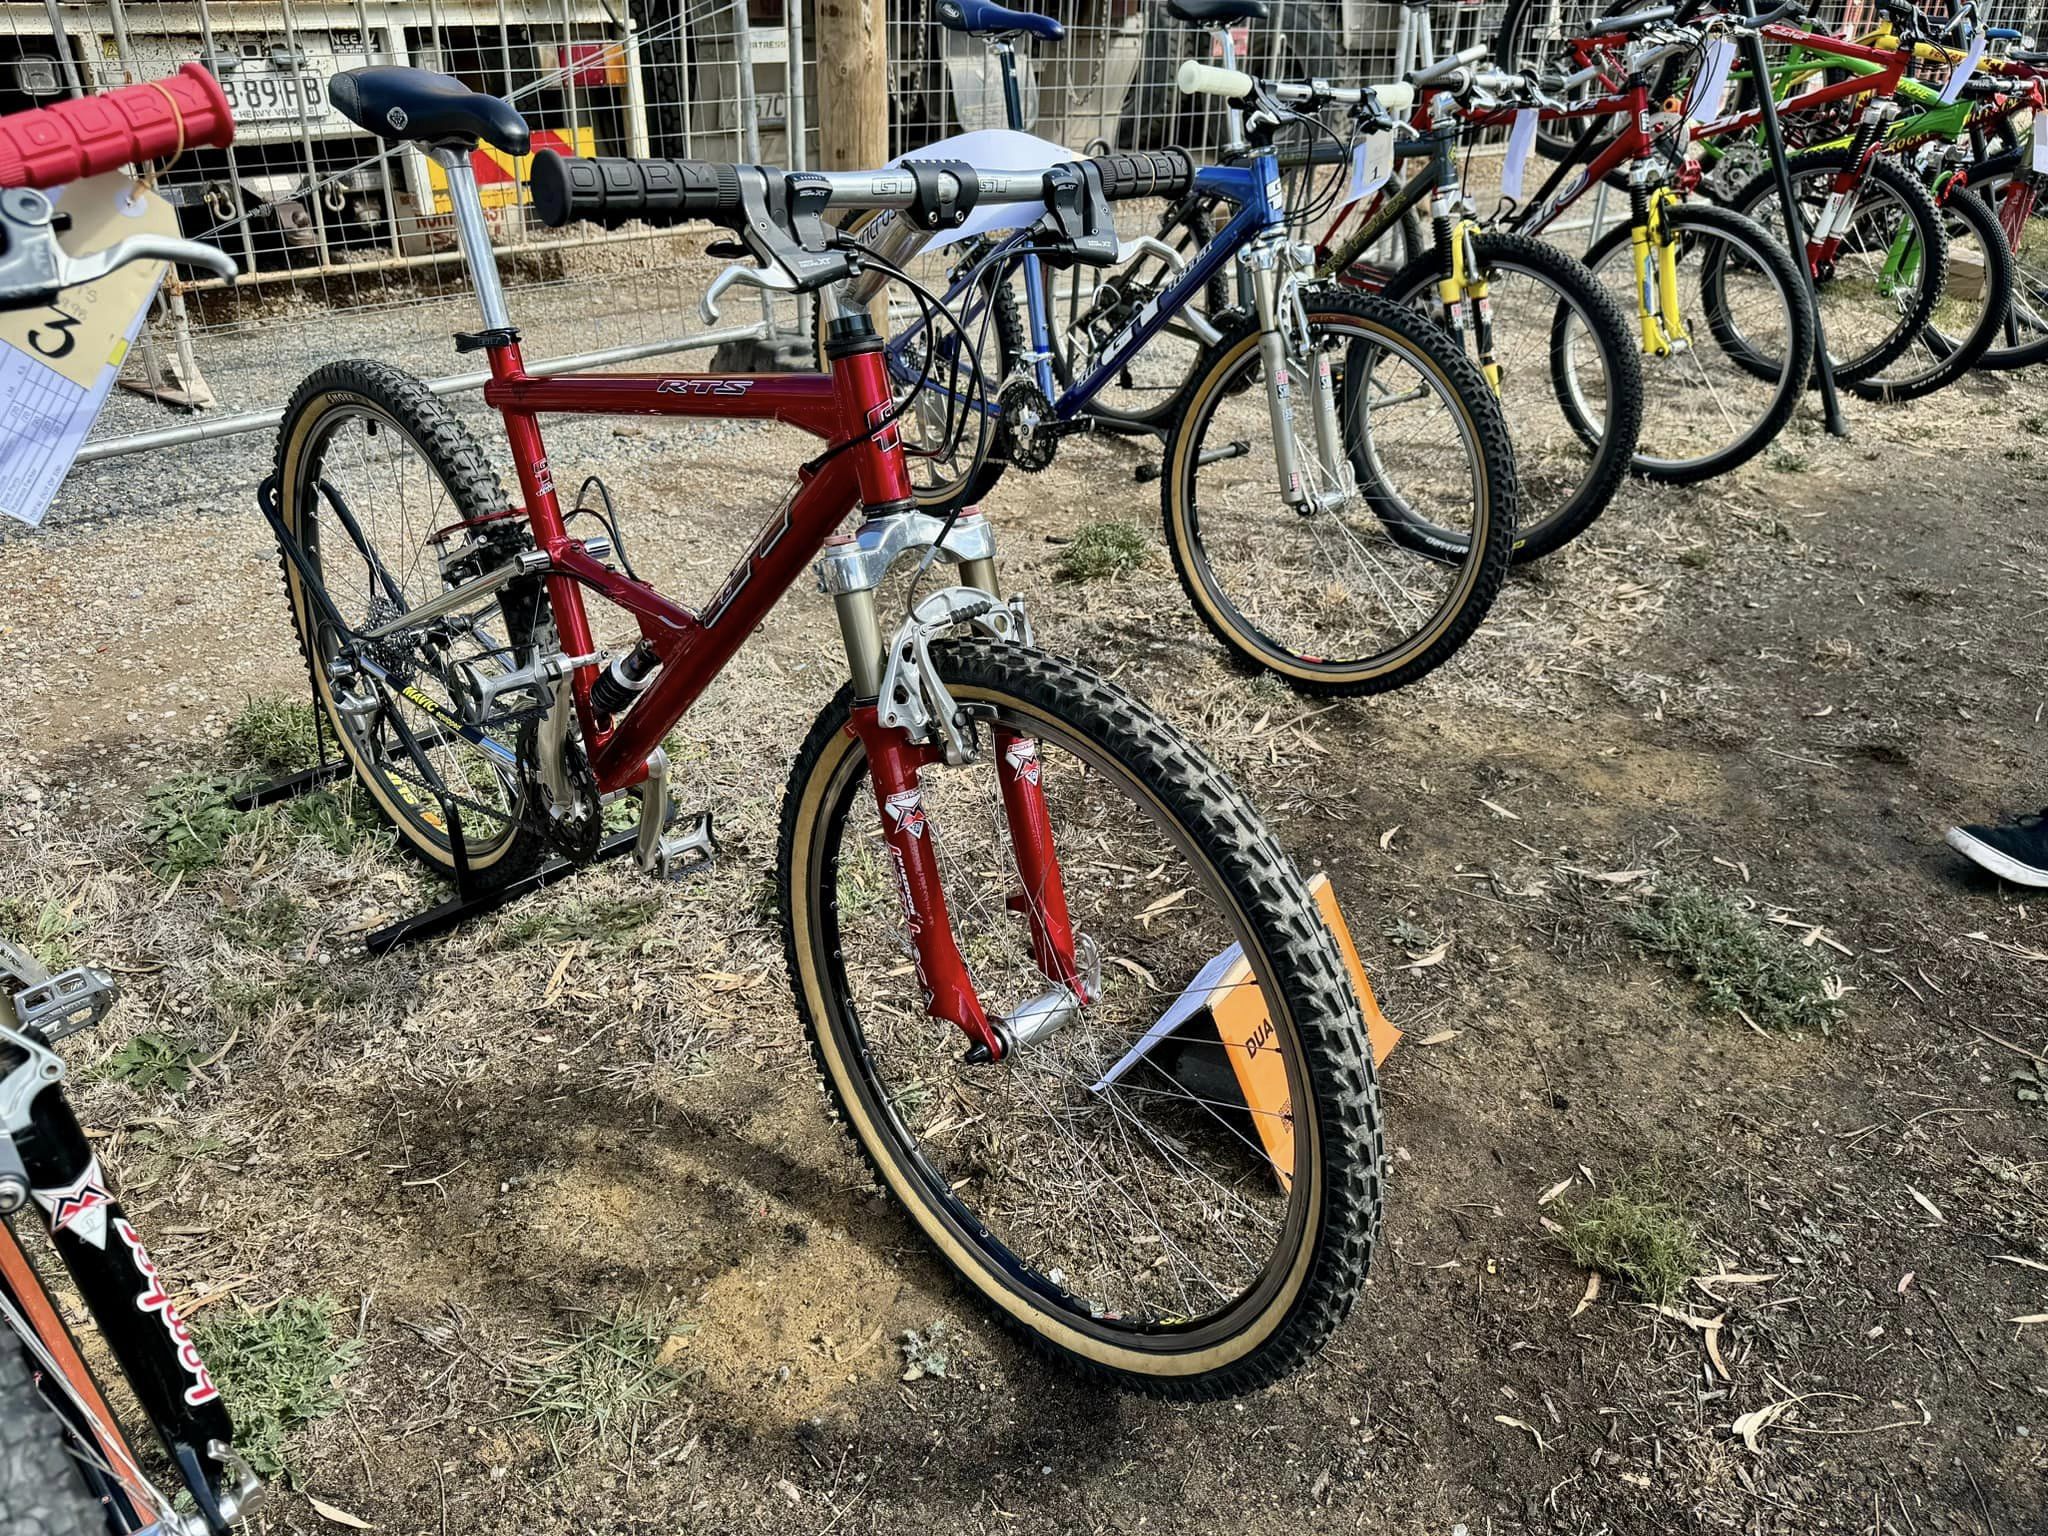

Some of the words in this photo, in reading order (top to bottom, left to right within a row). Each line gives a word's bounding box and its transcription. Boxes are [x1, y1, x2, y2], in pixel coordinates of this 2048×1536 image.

[570, 164, 708, 188] OURY
[656, 379, 755, 396] RTS
[402, 686, 439, 713] MAVIC
